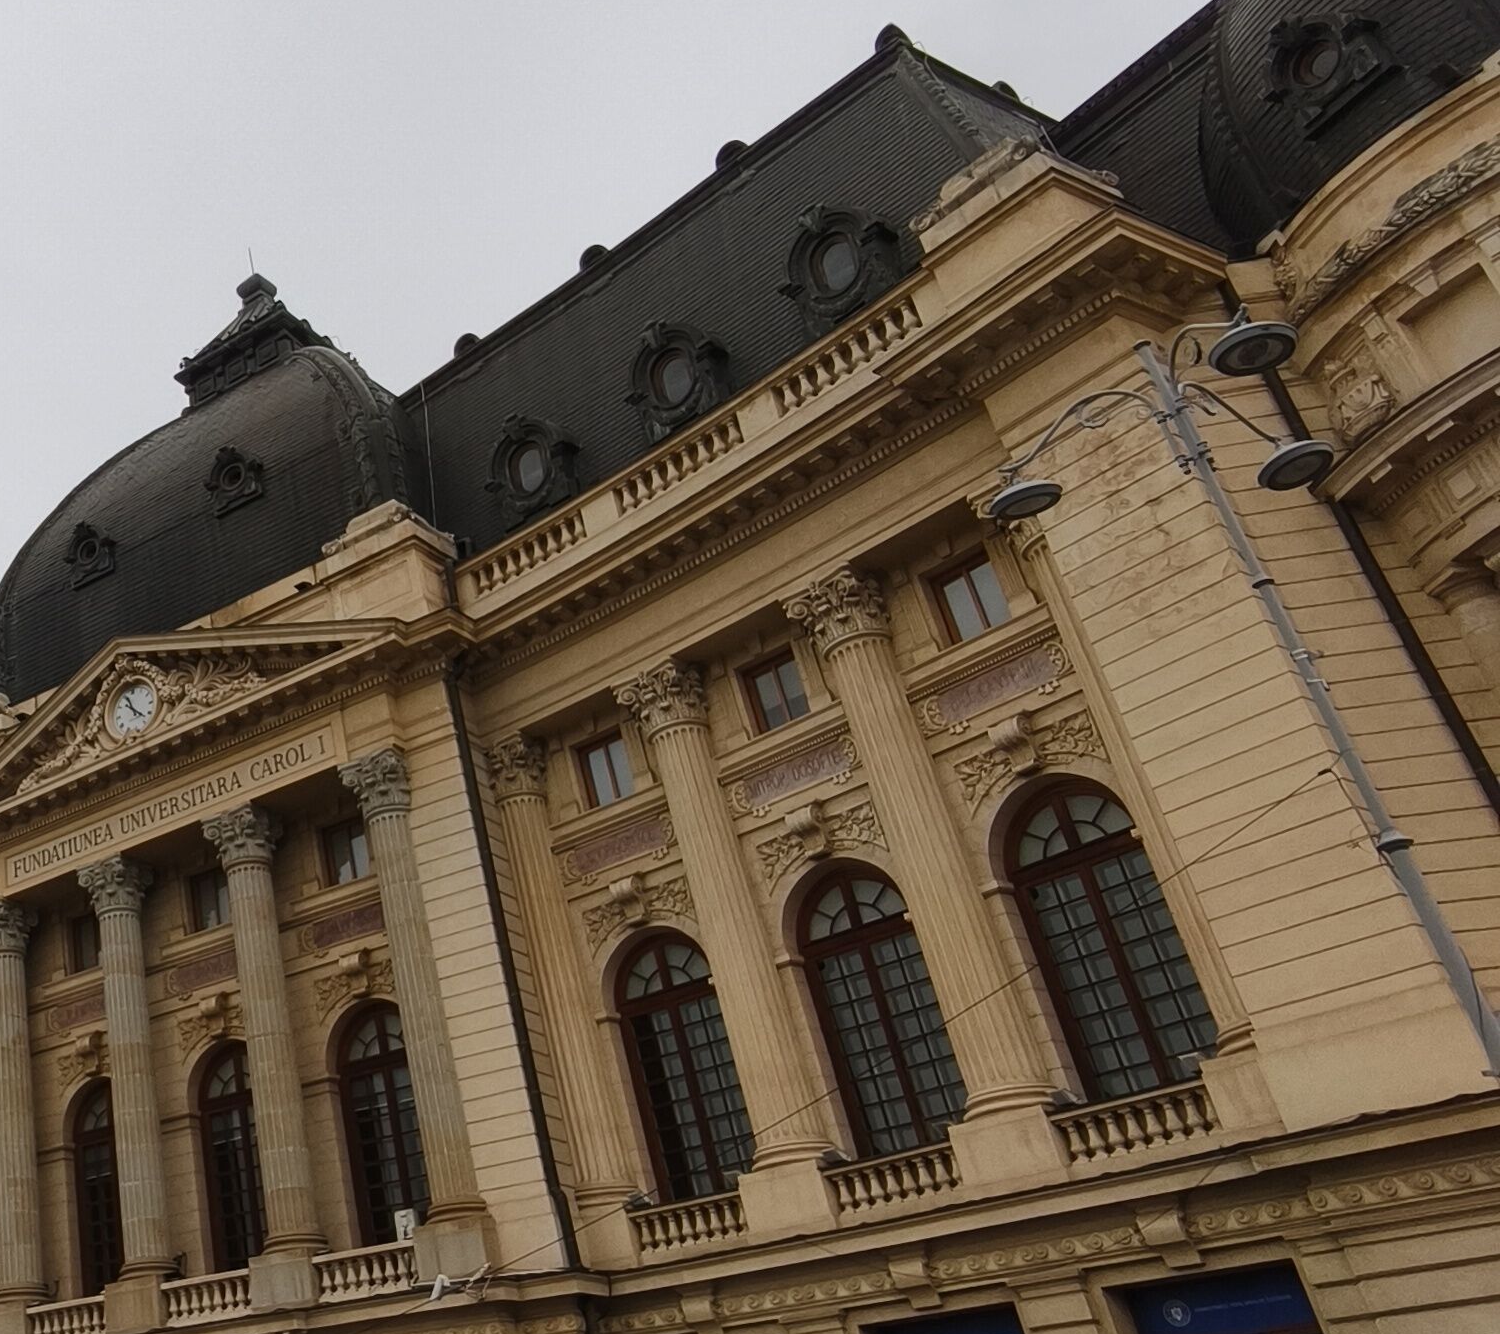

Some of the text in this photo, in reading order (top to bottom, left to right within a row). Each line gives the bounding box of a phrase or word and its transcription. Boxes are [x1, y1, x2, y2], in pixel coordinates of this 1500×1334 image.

[13, 734, 326, 878] FUNDATIUNEA UNIVERSITARA CAROL I
